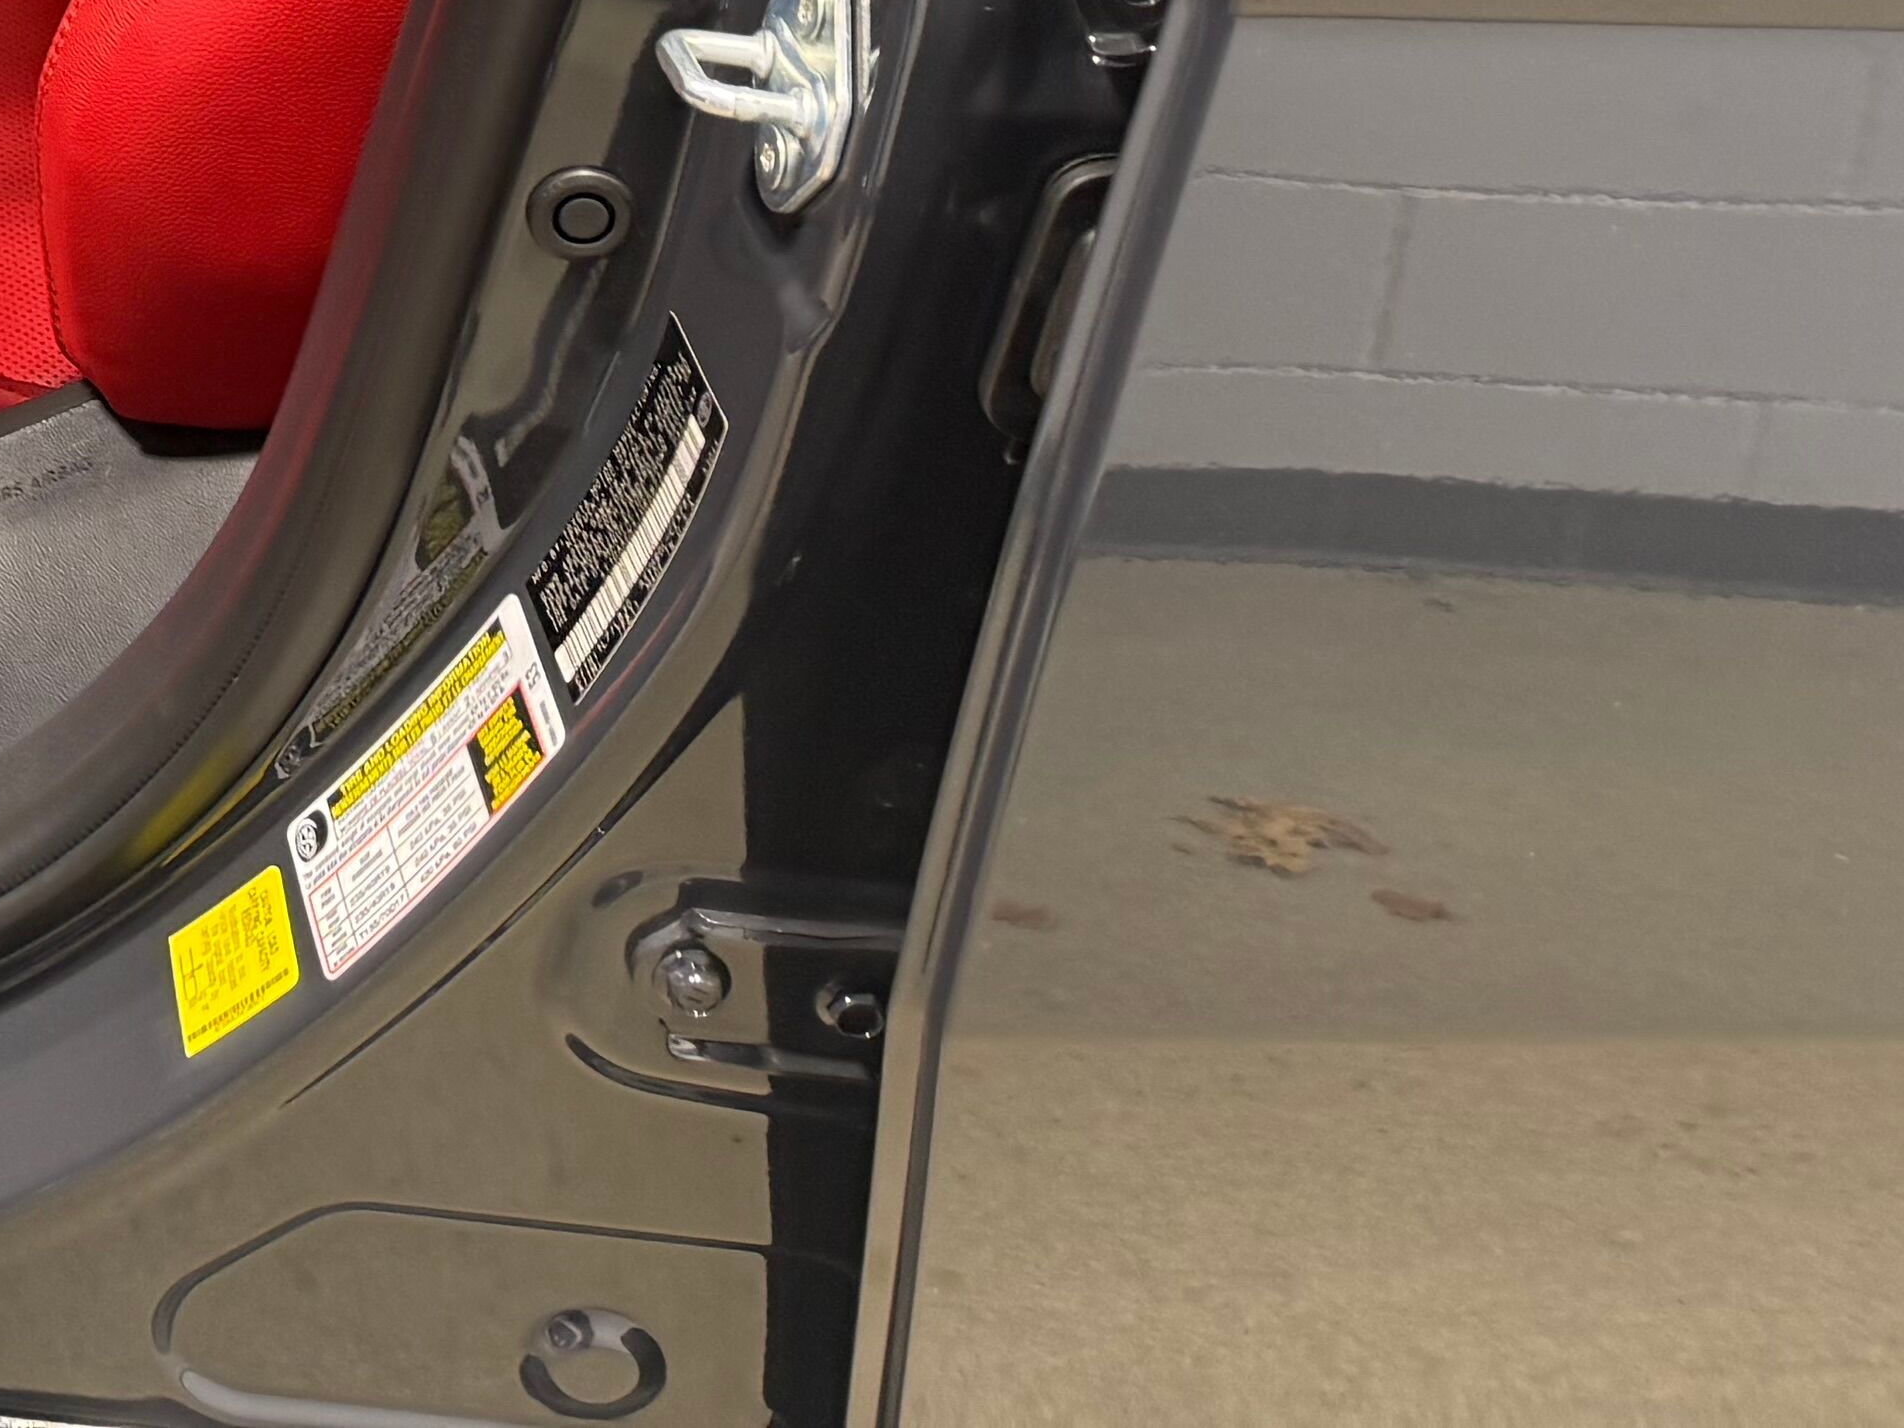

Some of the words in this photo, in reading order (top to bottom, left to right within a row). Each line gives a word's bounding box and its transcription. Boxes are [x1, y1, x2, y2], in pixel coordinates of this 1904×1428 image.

[362, 744, 385, 776] AND
[384, 700, 428, 753] LOADING
[426, 630, 491, 709] INFORMATION
